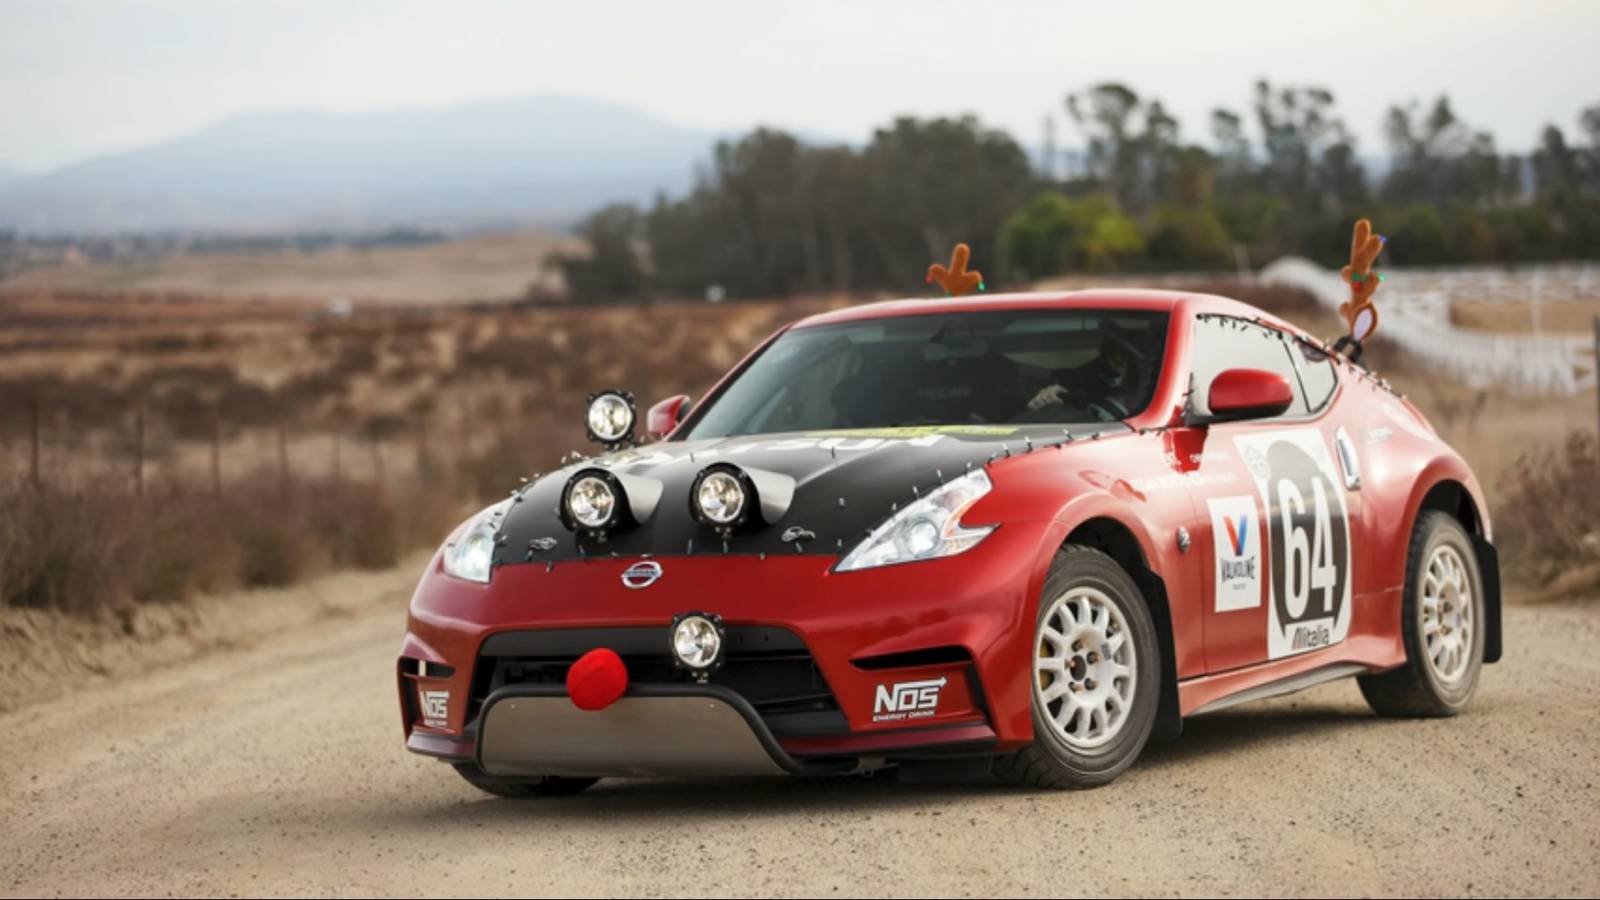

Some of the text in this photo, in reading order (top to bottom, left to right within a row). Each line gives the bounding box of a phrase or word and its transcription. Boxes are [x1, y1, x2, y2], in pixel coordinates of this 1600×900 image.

[1277, 475, 1336, 620] 64
[1220, 556, 1256, 582] VALVOLINE
[1291, 624, 1329, 650] Alitalia
[420, 691, 449, 719] NOS
[874, 678, 945, 713] NOS
